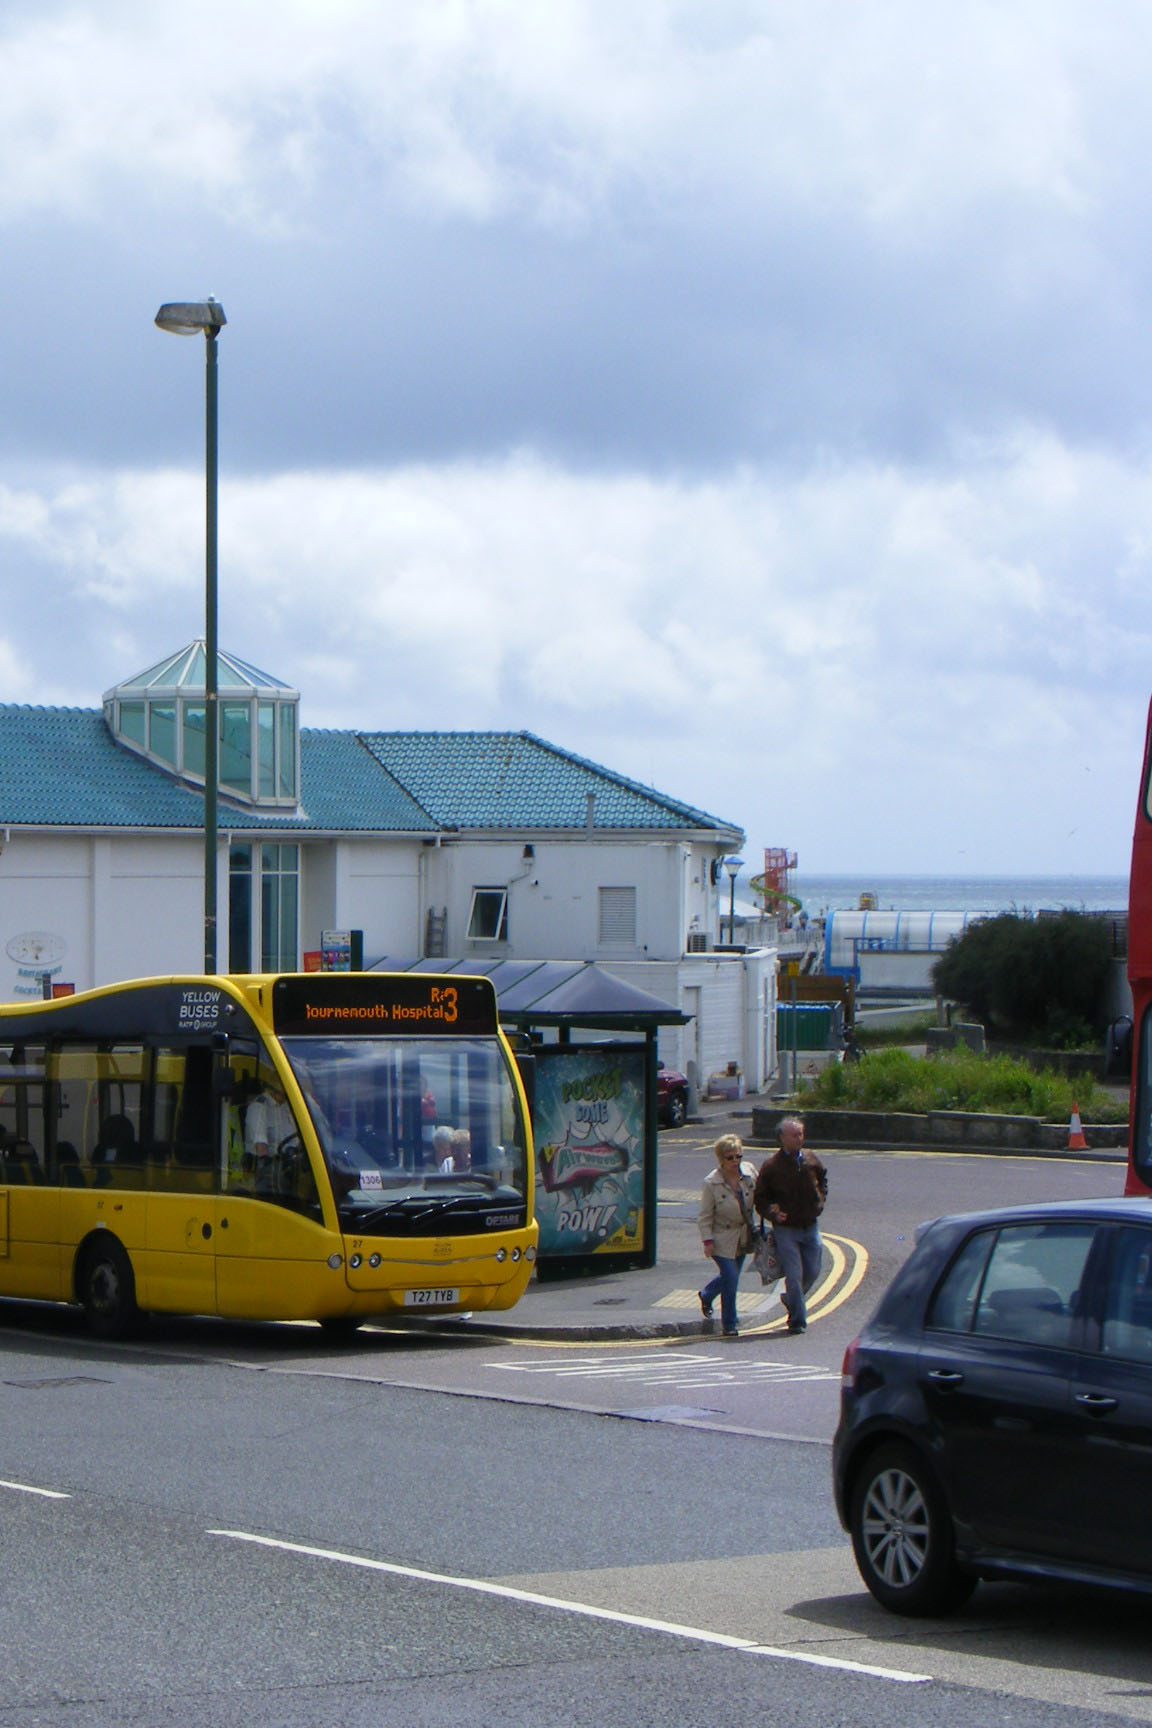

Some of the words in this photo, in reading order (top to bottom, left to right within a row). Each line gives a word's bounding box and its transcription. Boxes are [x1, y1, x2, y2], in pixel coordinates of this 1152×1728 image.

[182, 992, 221, 1003] YELLOW
[444, 987, 458, 1022] 3
[179, 1005, 219, 1018] BUSES
[392, 1004, 444, 1020] Hospital
[561, 1069, 622, 1104] POCKET
[575, 1103, 609, 1124] SOME
[556, 1205, 618, 1237] POW!
[352, 1240, 363, 1248] 27
[412, 1290, 431, 1303] T27
[434, 1289, 454, 1302] TYB
